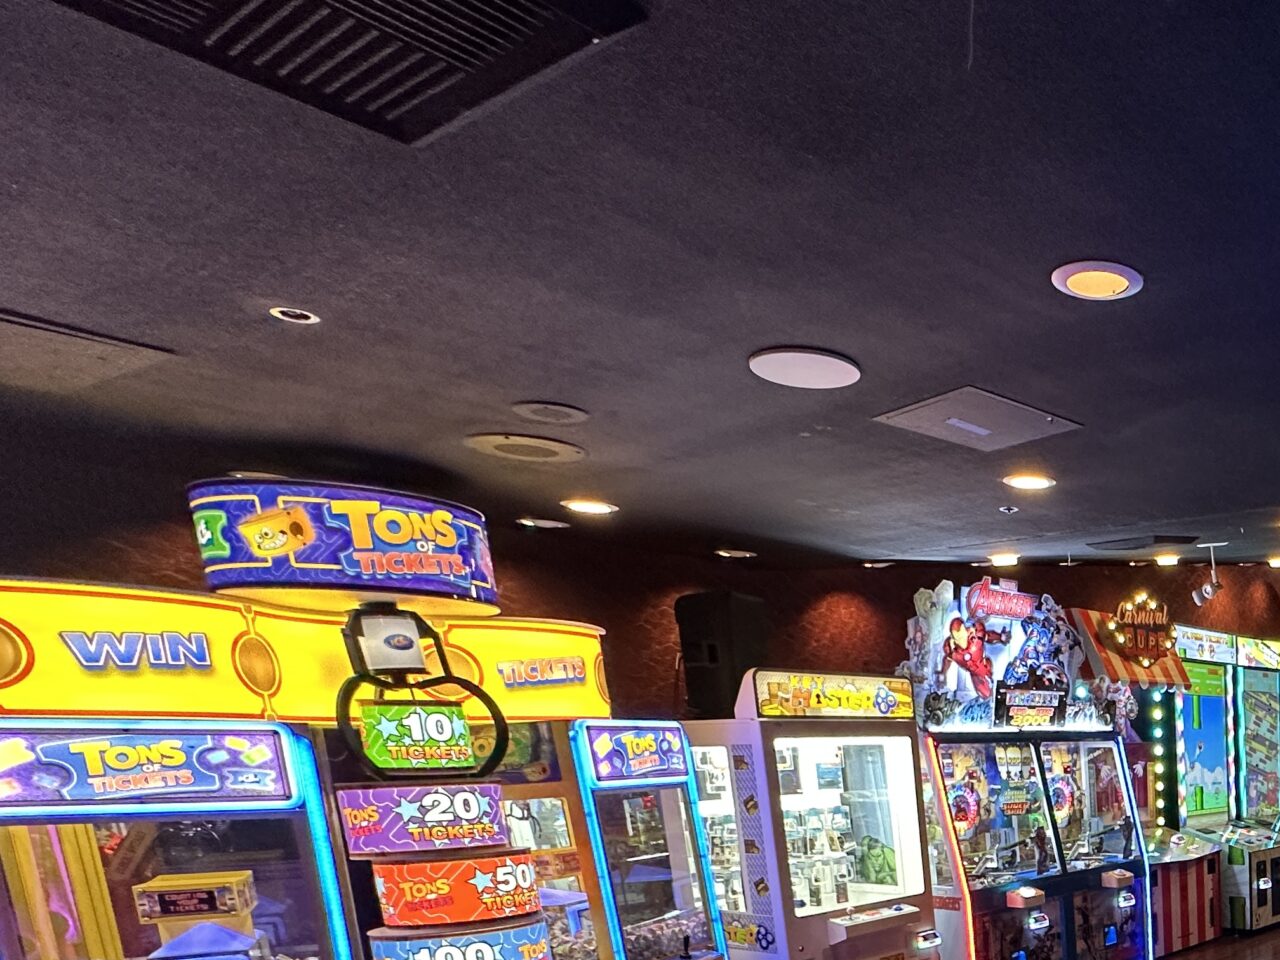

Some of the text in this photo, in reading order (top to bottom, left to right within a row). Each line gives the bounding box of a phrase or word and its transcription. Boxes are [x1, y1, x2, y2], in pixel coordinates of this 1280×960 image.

[330, 500, 457, 549] TONS
[416, 541, 436, 553] OF
[352, 551, 465, 576] TICKETS
[1114, 601, 1169, 628] Carnival
[58, 631, 212, 671] WIN
[497, 656, 586, 688] TICKETS
[402, 711, 453, 742] 10
[69, 739, 188, 776] TONS
[387, 745, 471, 760] TICKETS
[620, 732, 657, 759] TONS
[87, 770, 194, 793] TICKETS
[421, 791, 481, 823] 20
[408, 823, 496, 842] TICKETS
[399, 878, 450, 902] TONS
[495, 863, 531, 892] 50
[482, 890, 539, 911] TICKET
